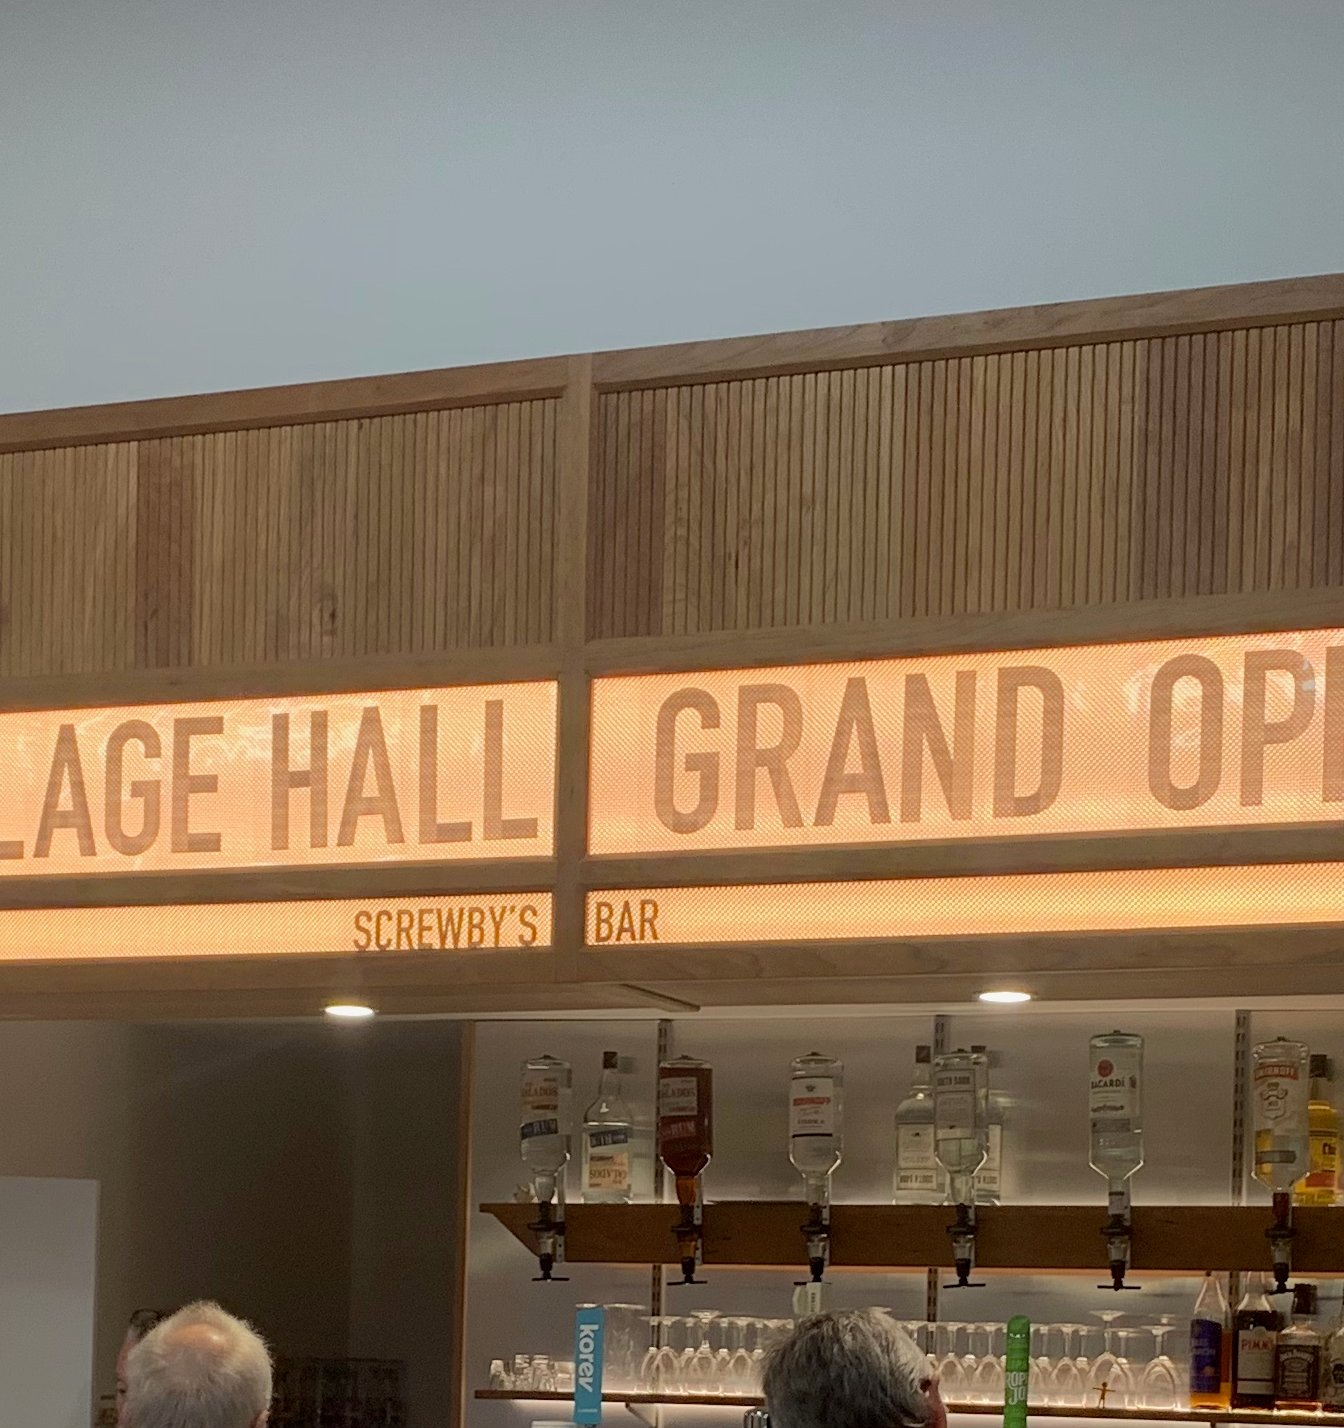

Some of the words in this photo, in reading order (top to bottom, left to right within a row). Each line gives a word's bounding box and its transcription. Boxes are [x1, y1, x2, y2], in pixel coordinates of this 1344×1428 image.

[269, 699, 539, 851] HALL
[653, 664, 1065, 835] GRAND
[355, 903, 538, 950] SCREWBY'S
[594, 899, 660, 944] BAR
[578, 1323, 600, 1389] korev
